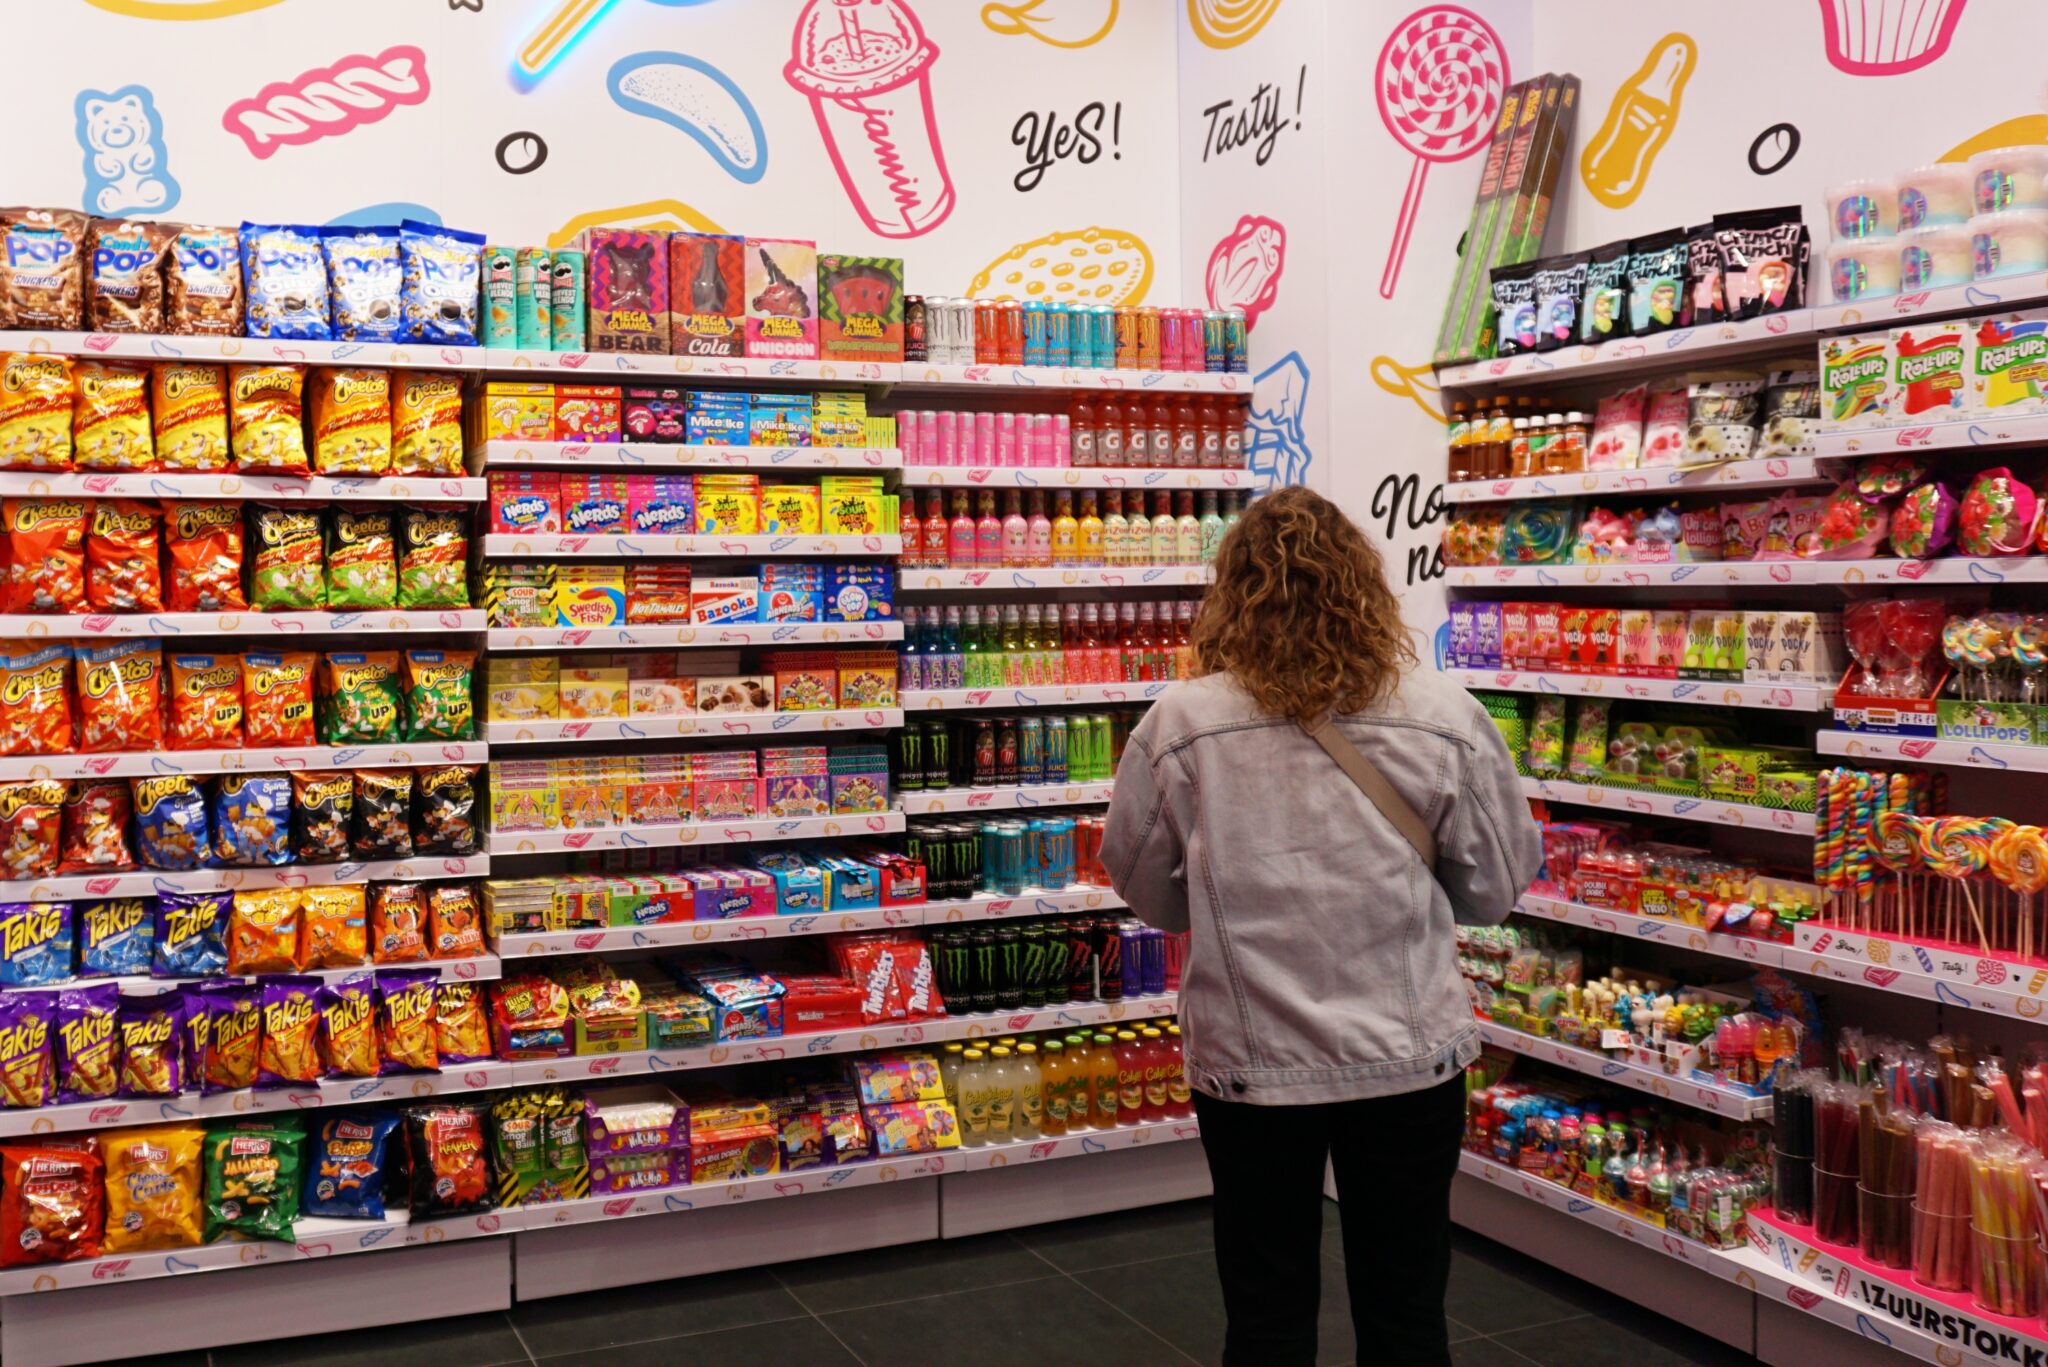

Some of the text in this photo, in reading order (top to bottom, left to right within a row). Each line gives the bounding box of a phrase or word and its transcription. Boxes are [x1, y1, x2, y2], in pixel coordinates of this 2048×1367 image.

[1203, 64, 1307, 166] Tasty!
[101, 235, 150, 250] Candy
[5, 236, 74, 267] POP
[93, 249, 156, 279] POP
[175, 248, 240, 272] POP
[13, 275, 59, 288] SNICKERS
[96, 285, 138, 297] SNICKERS
[187, 284, 230, 295] SNICKERS
[611, 311, 649, 322] MEGA
[691, 314, 727, 326] MEGA
[763, 318, 798, 329] MEGA
[846, 317, 880, 327] MEGA
[607, 320, 653, 331] GUMMIES
[688, 324, 731, 334] GUMMIES
[760, 327, 803, 338] GUMMIES
[843, 326, 884, 337] GUMMIES
[598, 335, 664, 350] BEAR
[688, 339, 731, 355] Cola
[750, 342, 816, 355] UNICORN
[4, 361, 64, 391] Cheetos
[165, 370, 218, 399] Cheetos
[236, 373, 292, 400] Cheetos
[334, 377, 388, 404] Cheetos
[404, 383, 458, 407] Cheetos
[690, 416, 744, 429] Mike Ike
[756, 421, 805, 432] Mike Ike
[819, 421, 843, 430] Mike
[713, 502, 738, 511] SOUR
[777, 503, 800, 512] SOUR
[838, 505, 866, 515] SOUR
[15, 503, 84, 533] Cheetos
[714, 509, 740, 520] PATCH
[777, 511, 803, 520] PATCH
[838, 513, 868, 525] PATCH
[93, 512, 152, 537] Cheetos
[178, 509, 238, 541] Cheetos
[263, 516, 317, 544] Cheetos
[339, 517, 387, 542] Cheetos
[408, 517, 459, 545] Cheetos
[1684, 516, 1721, 532] Unicor
[1684, 531, 1722, 545] lolligu
[512, 588, 534, 596] SOUR
[506, 597, 530, 607] Smog
[520, 604, 541, 613] Balls
[569, 602, 612, 617] Swedish
[631, 603, 651, 615] HOT
[696, 595, 754, 622] Bazooka
[580, 613, 604, 624] Fish
[86, 659, 153, 698] Cheetos
[186, 669, 237, 697] Cheetos
[254, 666, 304, 695] Cheetos
[342, 665, 387, 692] Cheetos
[419, 665, 466, 689] Cheetos
[216, 706, 239, 721] UP!
[284, 703, 307, 718] UP!
[1943, 724, 2030, 742] LOLLIPOPS
[0, 785, 65, 821] Cheetos
[1644, 902, 1668, 915] TRIO
[84, 901, 144, 948] Takis
[165, 900, 219, 949] Takis
[0, 909, 62, 960] Takis
[1942, 960, 1968, 975] Tasty!
[506, 992, 532, 1008] JUICY
[385, 988, 434, 1028] Takis
[264, 999, 314, 1034] Takis
[322, 994, 370, 1040] Takis
[60, 1013, 114, 1061] Takis
[122, 1017, 173, 1045] Takis
[213, 1007, 259, 1053] Takis
[0, 1022, 48, 1062] Takis
[507, 1120, 530, 1131] SOUR
[553, 1117, 575, 1128] SOUR
[502, 1132, 525, 1142] Smog
[550, 1129, 571, 1140] Smog
[438, 1140, 477, 1154] REAPER
[515, 1139, 536, 1149] Balls
